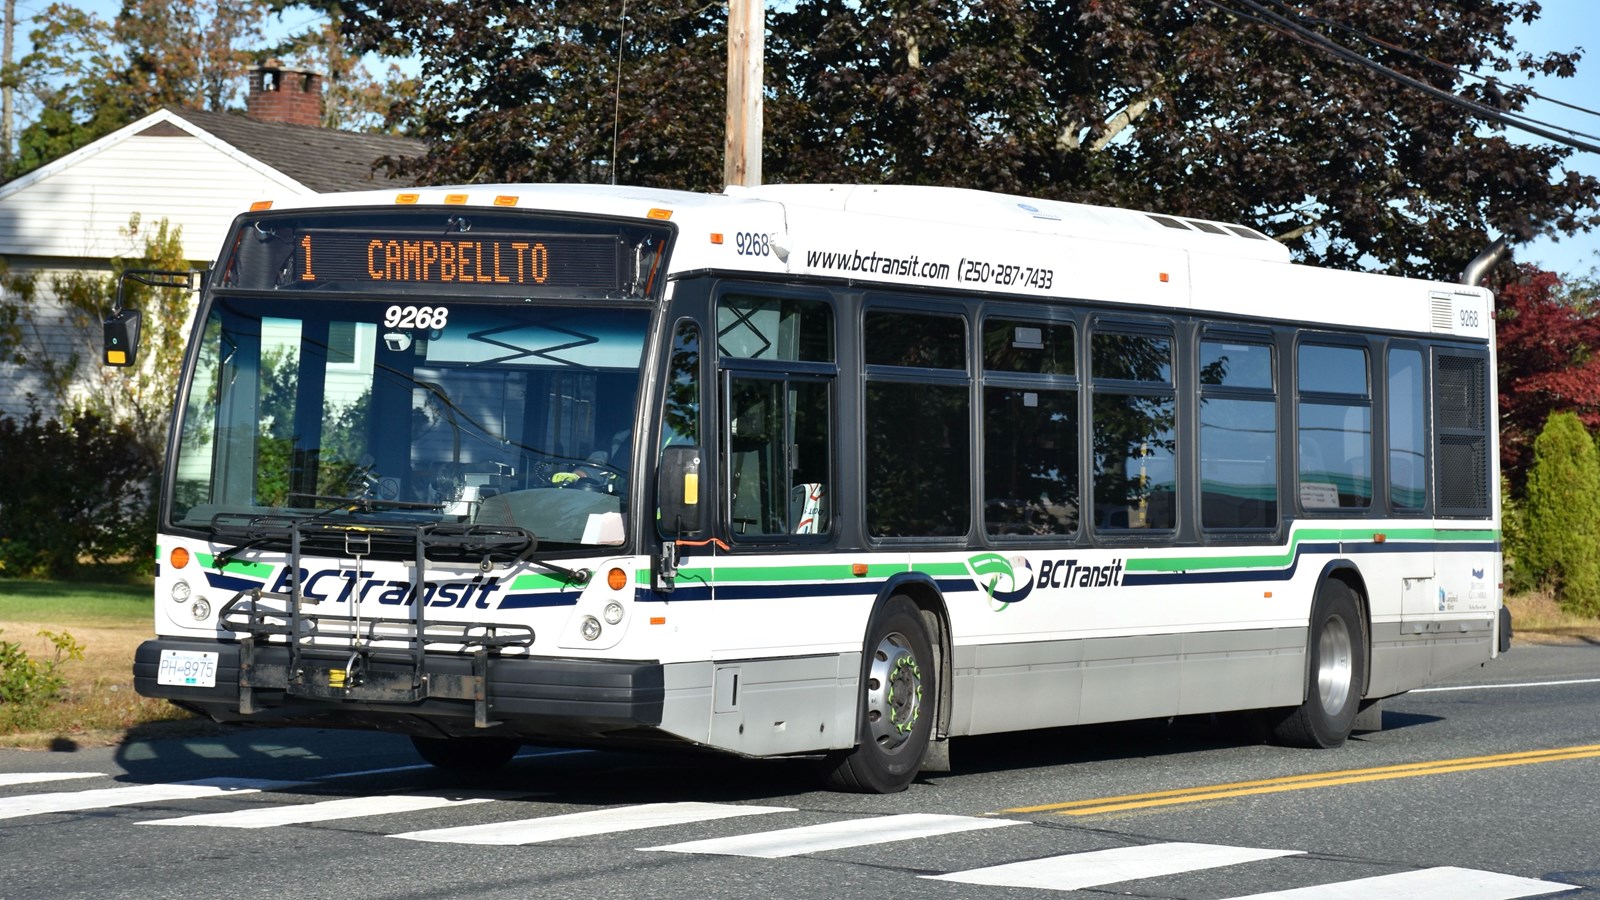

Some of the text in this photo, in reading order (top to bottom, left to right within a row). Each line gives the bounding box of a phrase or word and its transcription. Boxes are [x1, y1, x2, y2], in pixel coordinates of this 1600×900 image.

[736, 231, 770, 257] 9268
[300, 235, 316, 281] 1
[806, 249, 950, 281] www.bctransit.com
[384, 305, 448, 330] 9268
[1460, 309, 1479, 328] 9268
